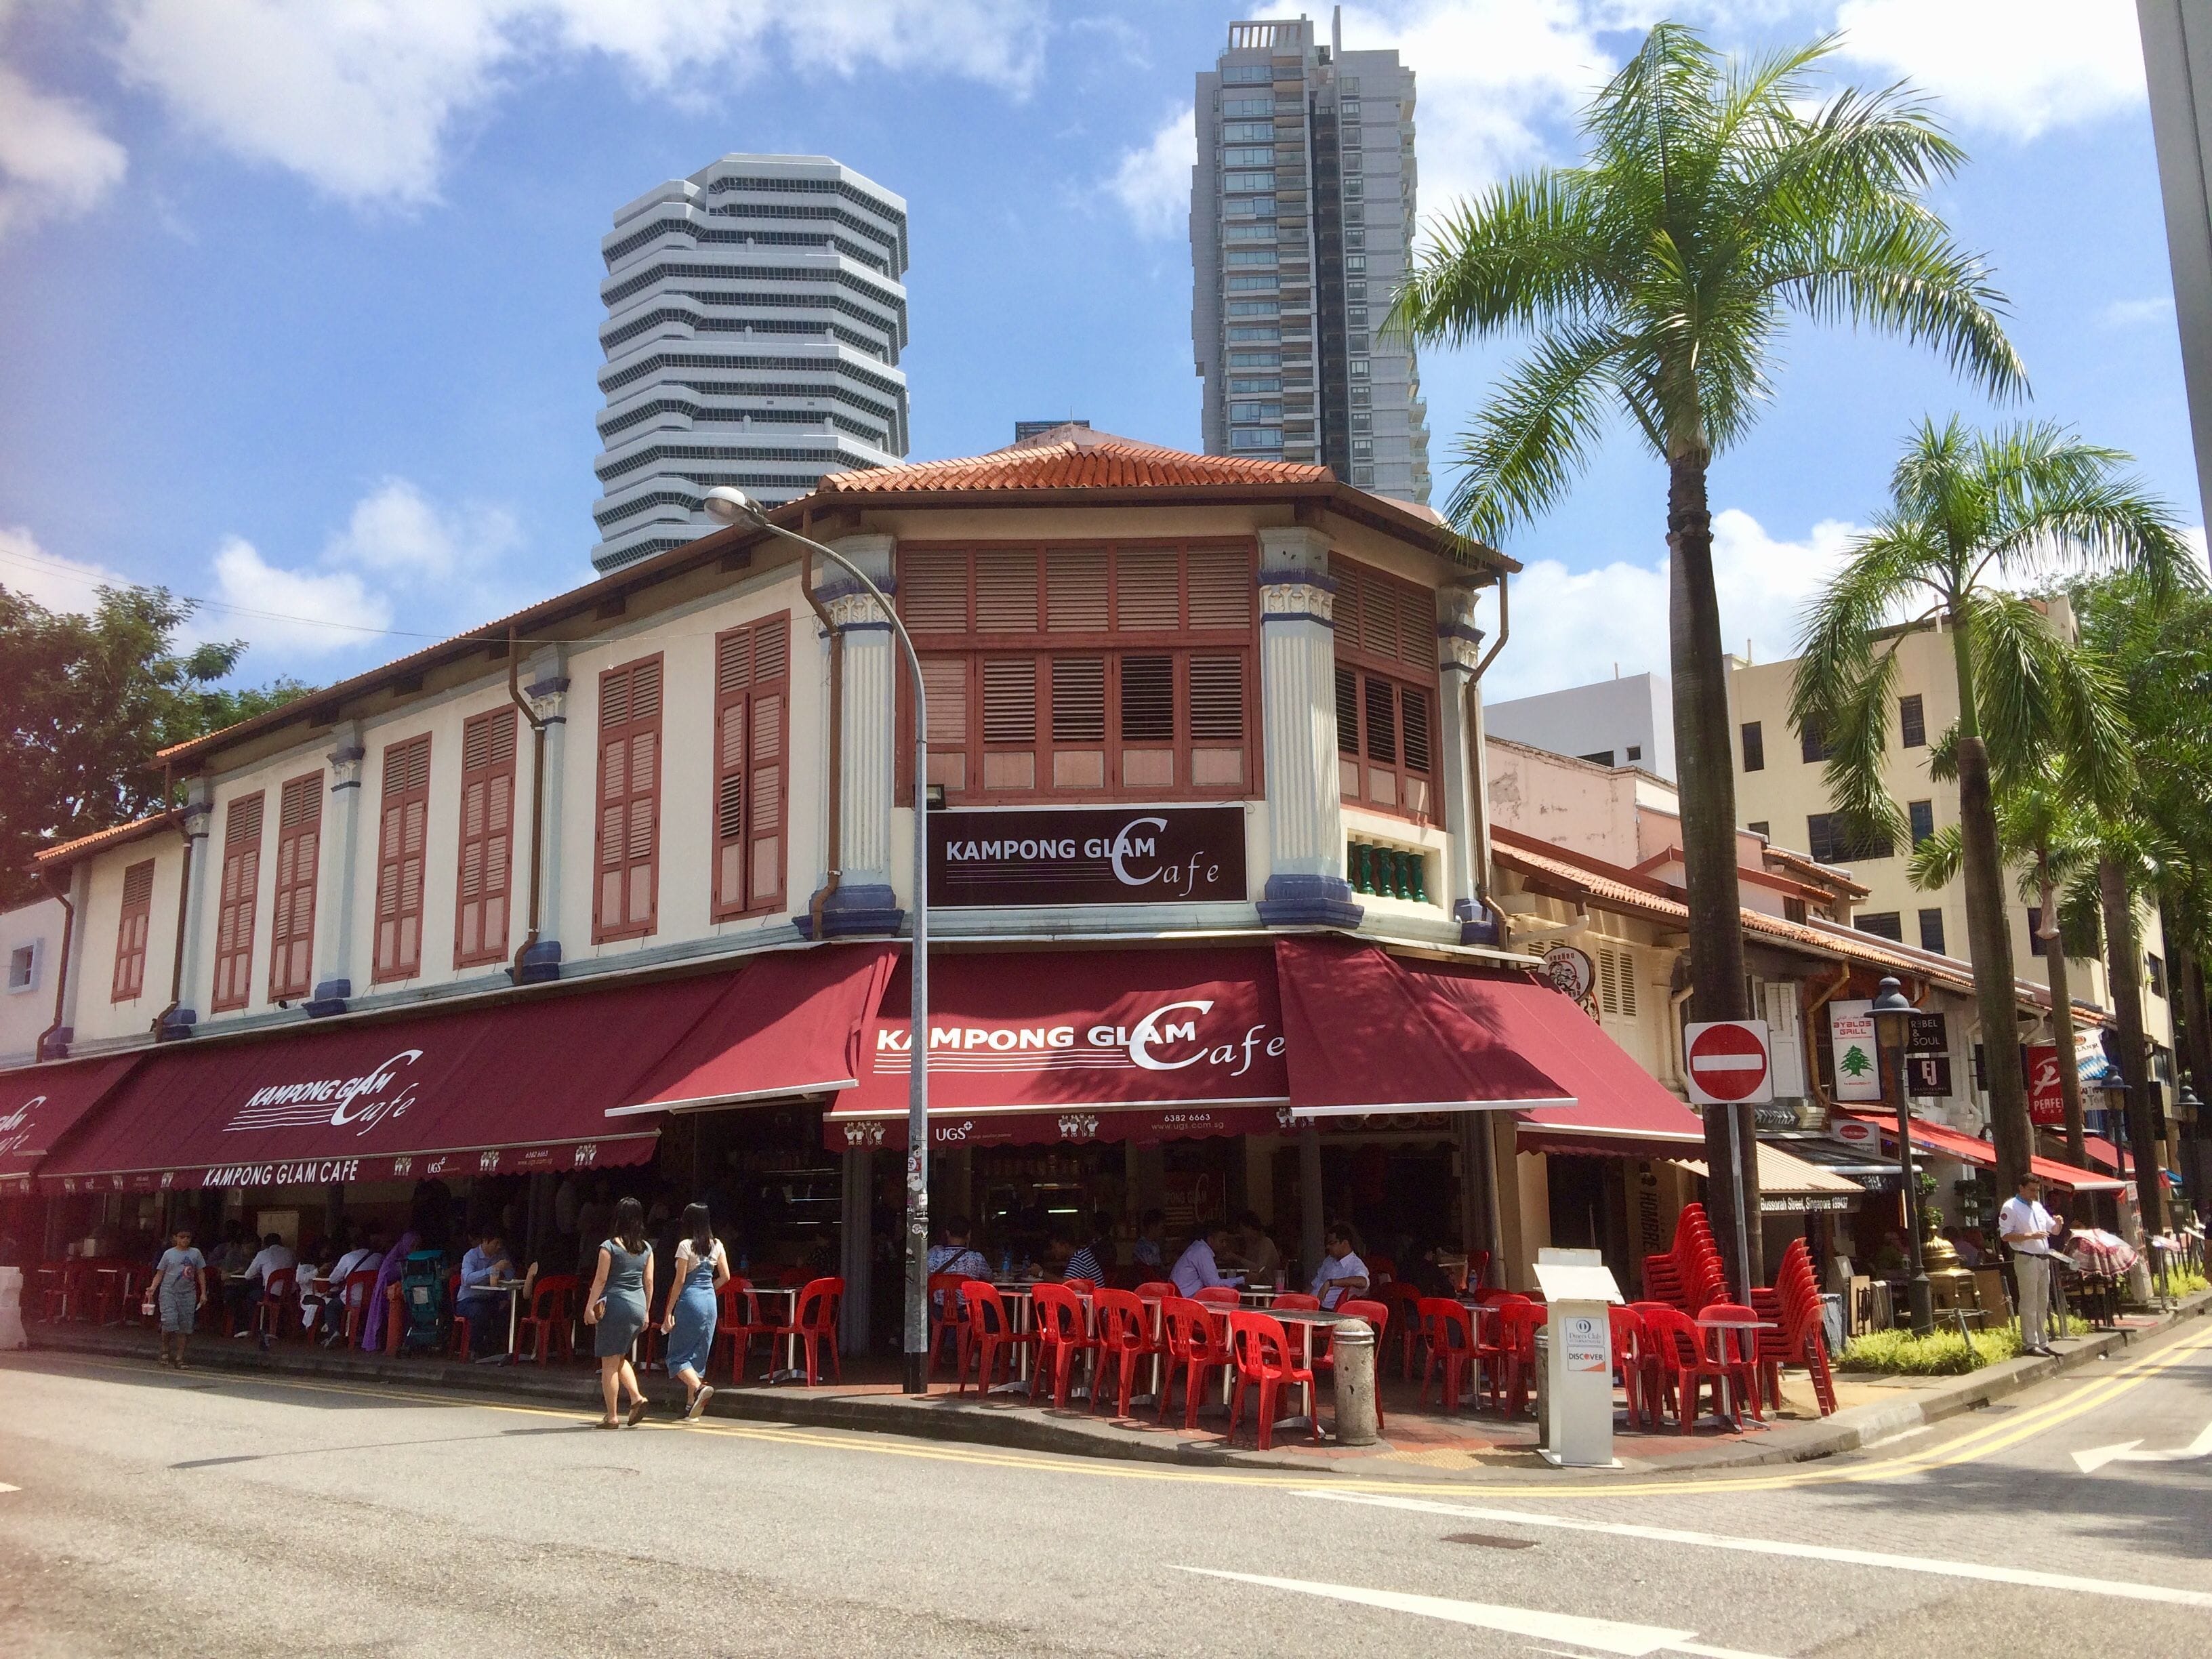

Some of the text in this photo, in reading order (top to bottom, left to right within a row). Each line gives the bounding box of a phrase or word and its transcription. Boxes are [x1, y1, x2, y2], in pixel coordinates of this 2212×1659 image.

[946, 837, 1155, 861] KAMPONG GLAM
[1111, 817, 1218, 897] Cafe
[1833, 1021, 1872, 1029] BYBLOS
[1087, 1021, 1195, 1047] GLAM
[1129, 1000, 1286, 1076] Cafe
[1912, 1029, 1920, 1037] &
[1913, 1036, 1940, 1046] SOUL
[244, 1071, 396, 1107] KAMPONG GLAM
[330, 1048, 424, 1136] Cafe
[1164, 1113, 1210, 1122] 6382 6663
[935, 1127, 966, 1141] UGS
[1151, 1122, 1224, 1131] www.ugs.com.sg
[202, 1160, 359, 1187] KAMPONG GLAM CAFE
[428, 1162, 442, 1174] UGS
[1760, 1197, 1787, 1211] Bussorah
[1787, 1197, 1805, 1212] Street,
[1805, 1196, 1831, 1212] Singapore
[1568, 1353, 1603, 1361] DISCOVER
